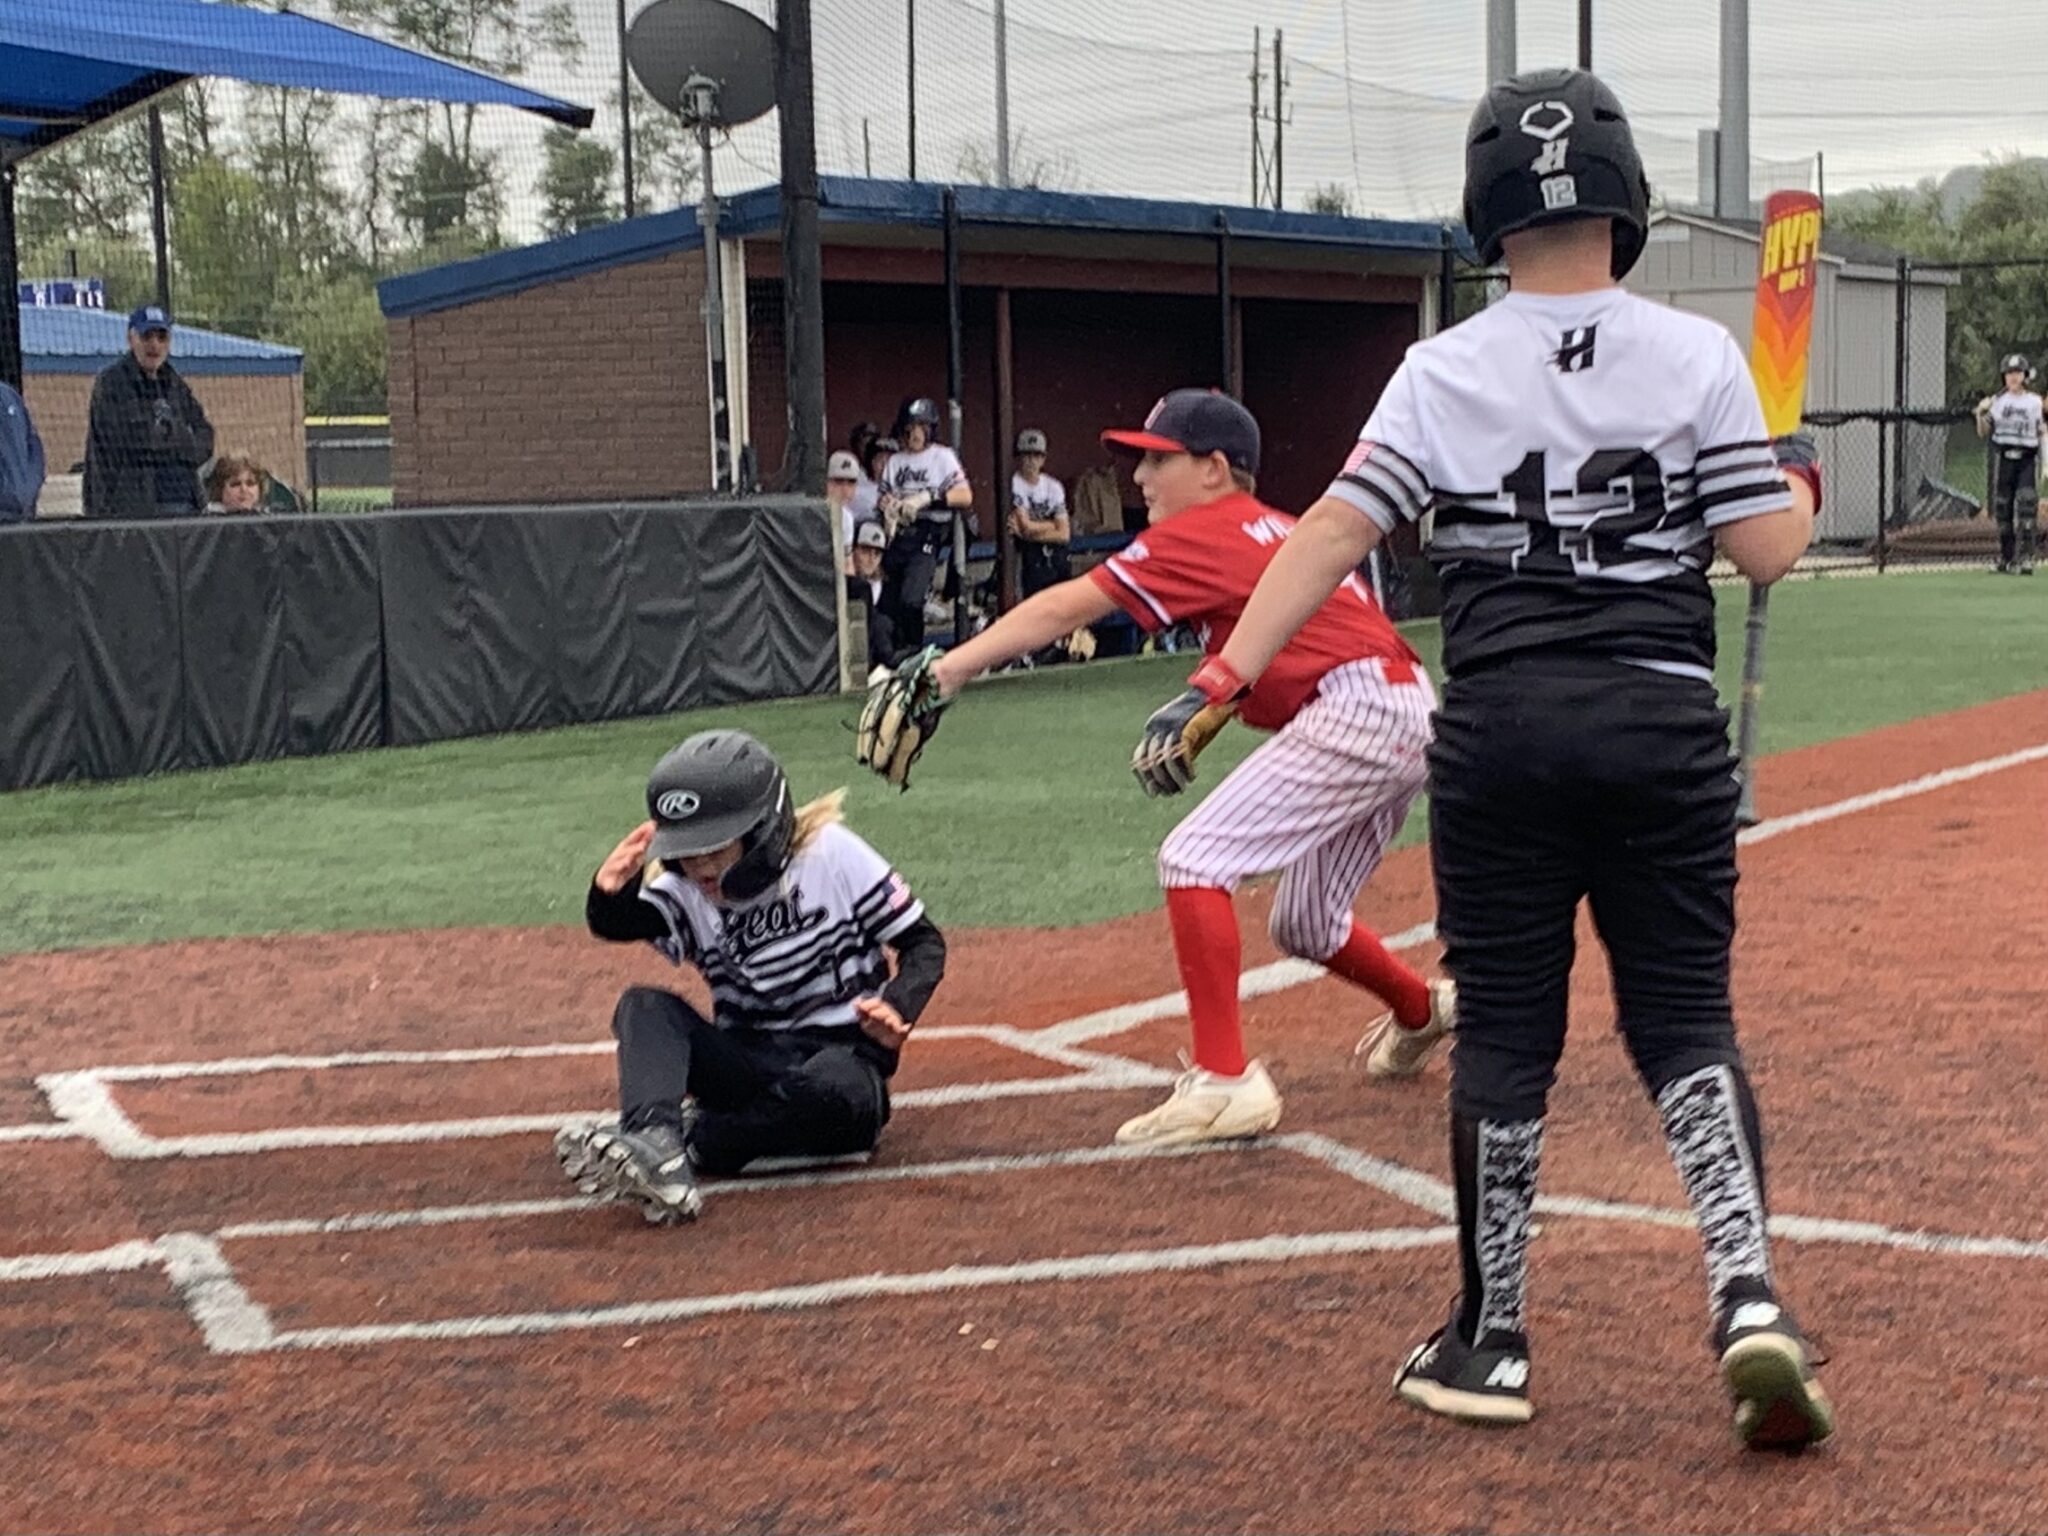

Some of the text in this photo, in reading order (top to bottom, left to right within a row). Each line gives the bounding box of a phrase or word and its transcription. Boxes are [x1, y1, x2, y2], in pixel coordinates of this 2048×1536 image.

[1540, 174, 1577, 210] 12
[1762, 209, 1822, 279] HYP
[1499, 448, 1667, 576] 12
